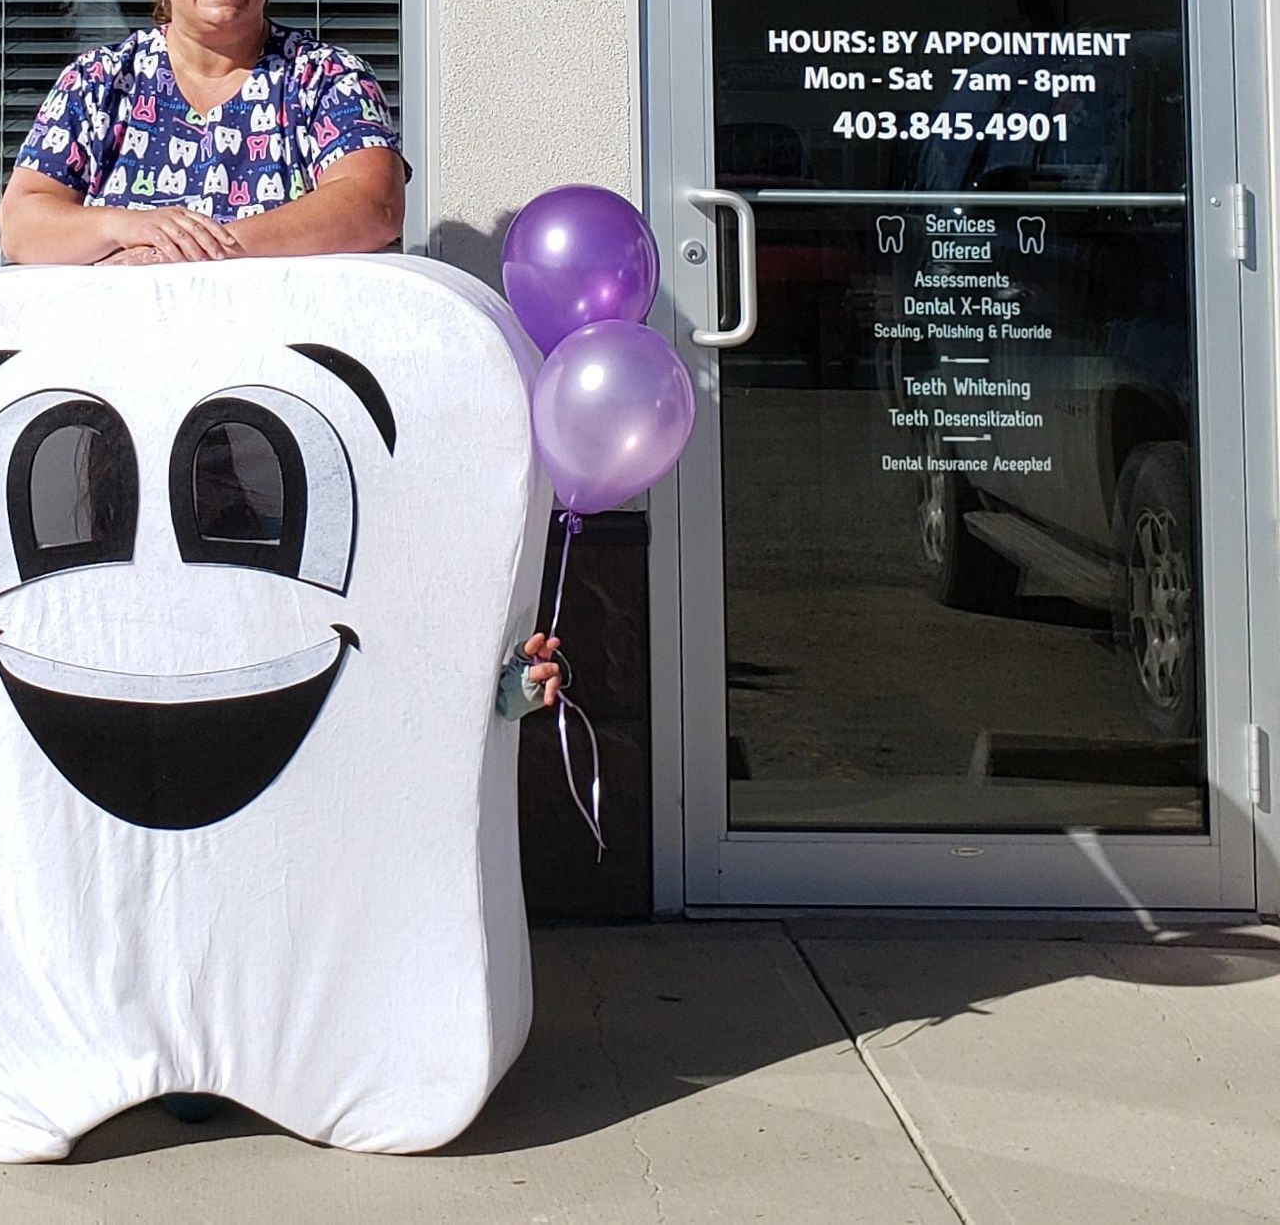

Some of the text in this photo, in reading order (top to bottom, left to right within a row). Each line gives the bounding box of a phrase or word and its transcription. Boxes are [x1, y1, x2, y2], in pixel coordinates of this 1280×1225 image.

[768, 29, 1131, 57] HOURS: BY APPOINTMENT
[804, 66, 865, 90] Mon
[888, 66, 933, 91] Sat
[951, 68, 1011, 92] 7am
[1034, 69, 1096, 98] 8pm
[832, 111, 1067, 142] 403.845.4901
[925, 213, 996, 233] Services
[931, 241, 991, 260] Offered
[914, 270, 1010, 289] Assessments
[904, 296, 1021, 320] Dental X-Rays
[874, 323, 1053, 342] Scaling, Polishing & Fluoride
[903, 376, 1031, 401] Teeth Whitening
[887, 408, 1043, 427] Teeth Desensitization
[882, 455, 924, 471] Dental
[927, 455, 988, 472] Insurance
